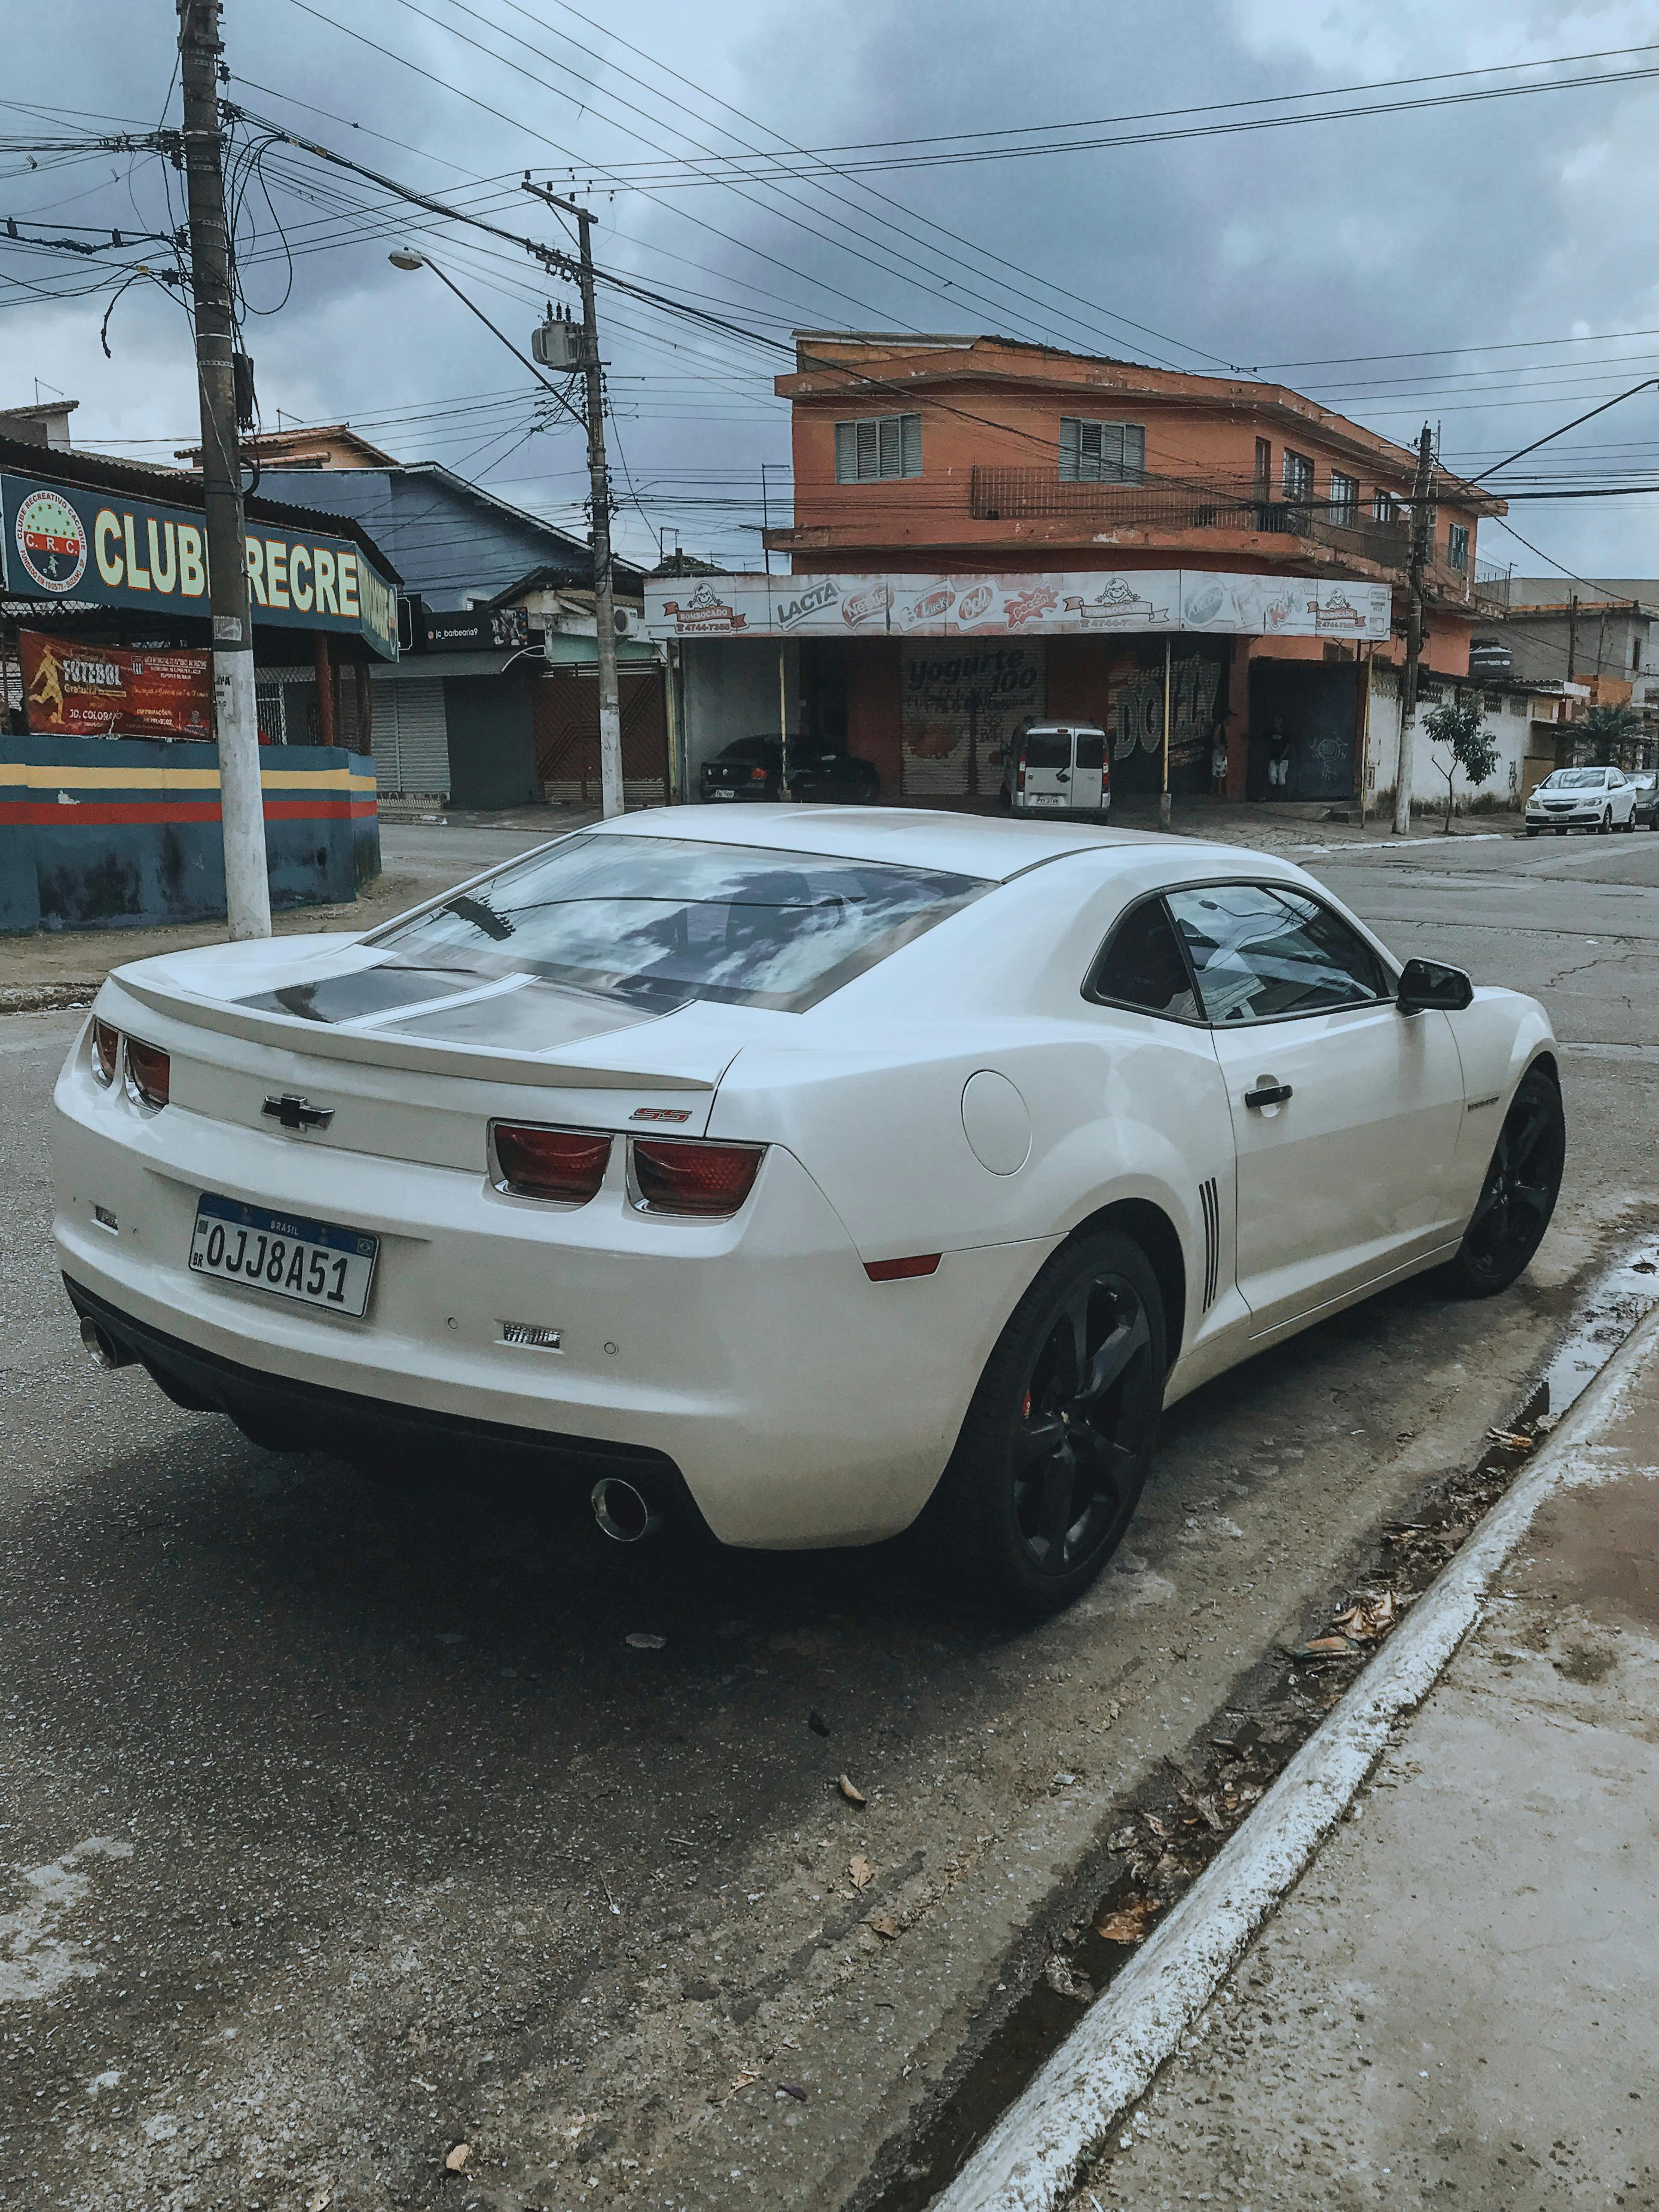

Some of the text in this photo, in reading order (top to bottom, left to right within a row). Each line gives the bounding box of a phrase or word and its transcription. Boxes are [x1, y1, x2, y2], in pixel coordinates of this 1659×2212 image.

[17, 492, 85, 551] CLUBE RECREATIVO CACIQUE
[26, 534, 78, 555] C. R. C.
[20, 550, 38, 578] FUNDADO
[94, 508, 211, 599] CLUB
[245, 535, 359, 618] RECRE
[777, 582, 838, 623] LACTA
[680, 609, 728, 621] BOMBOCADO
[63, 659, 122, 686] FUTEBOL
[69, 709, 81, 718] JD.
[628, 1108, 693, 1123] SS
[270, 1220, 298, 1236] BRASIL
[193, 1252, 203, 1267] BR
